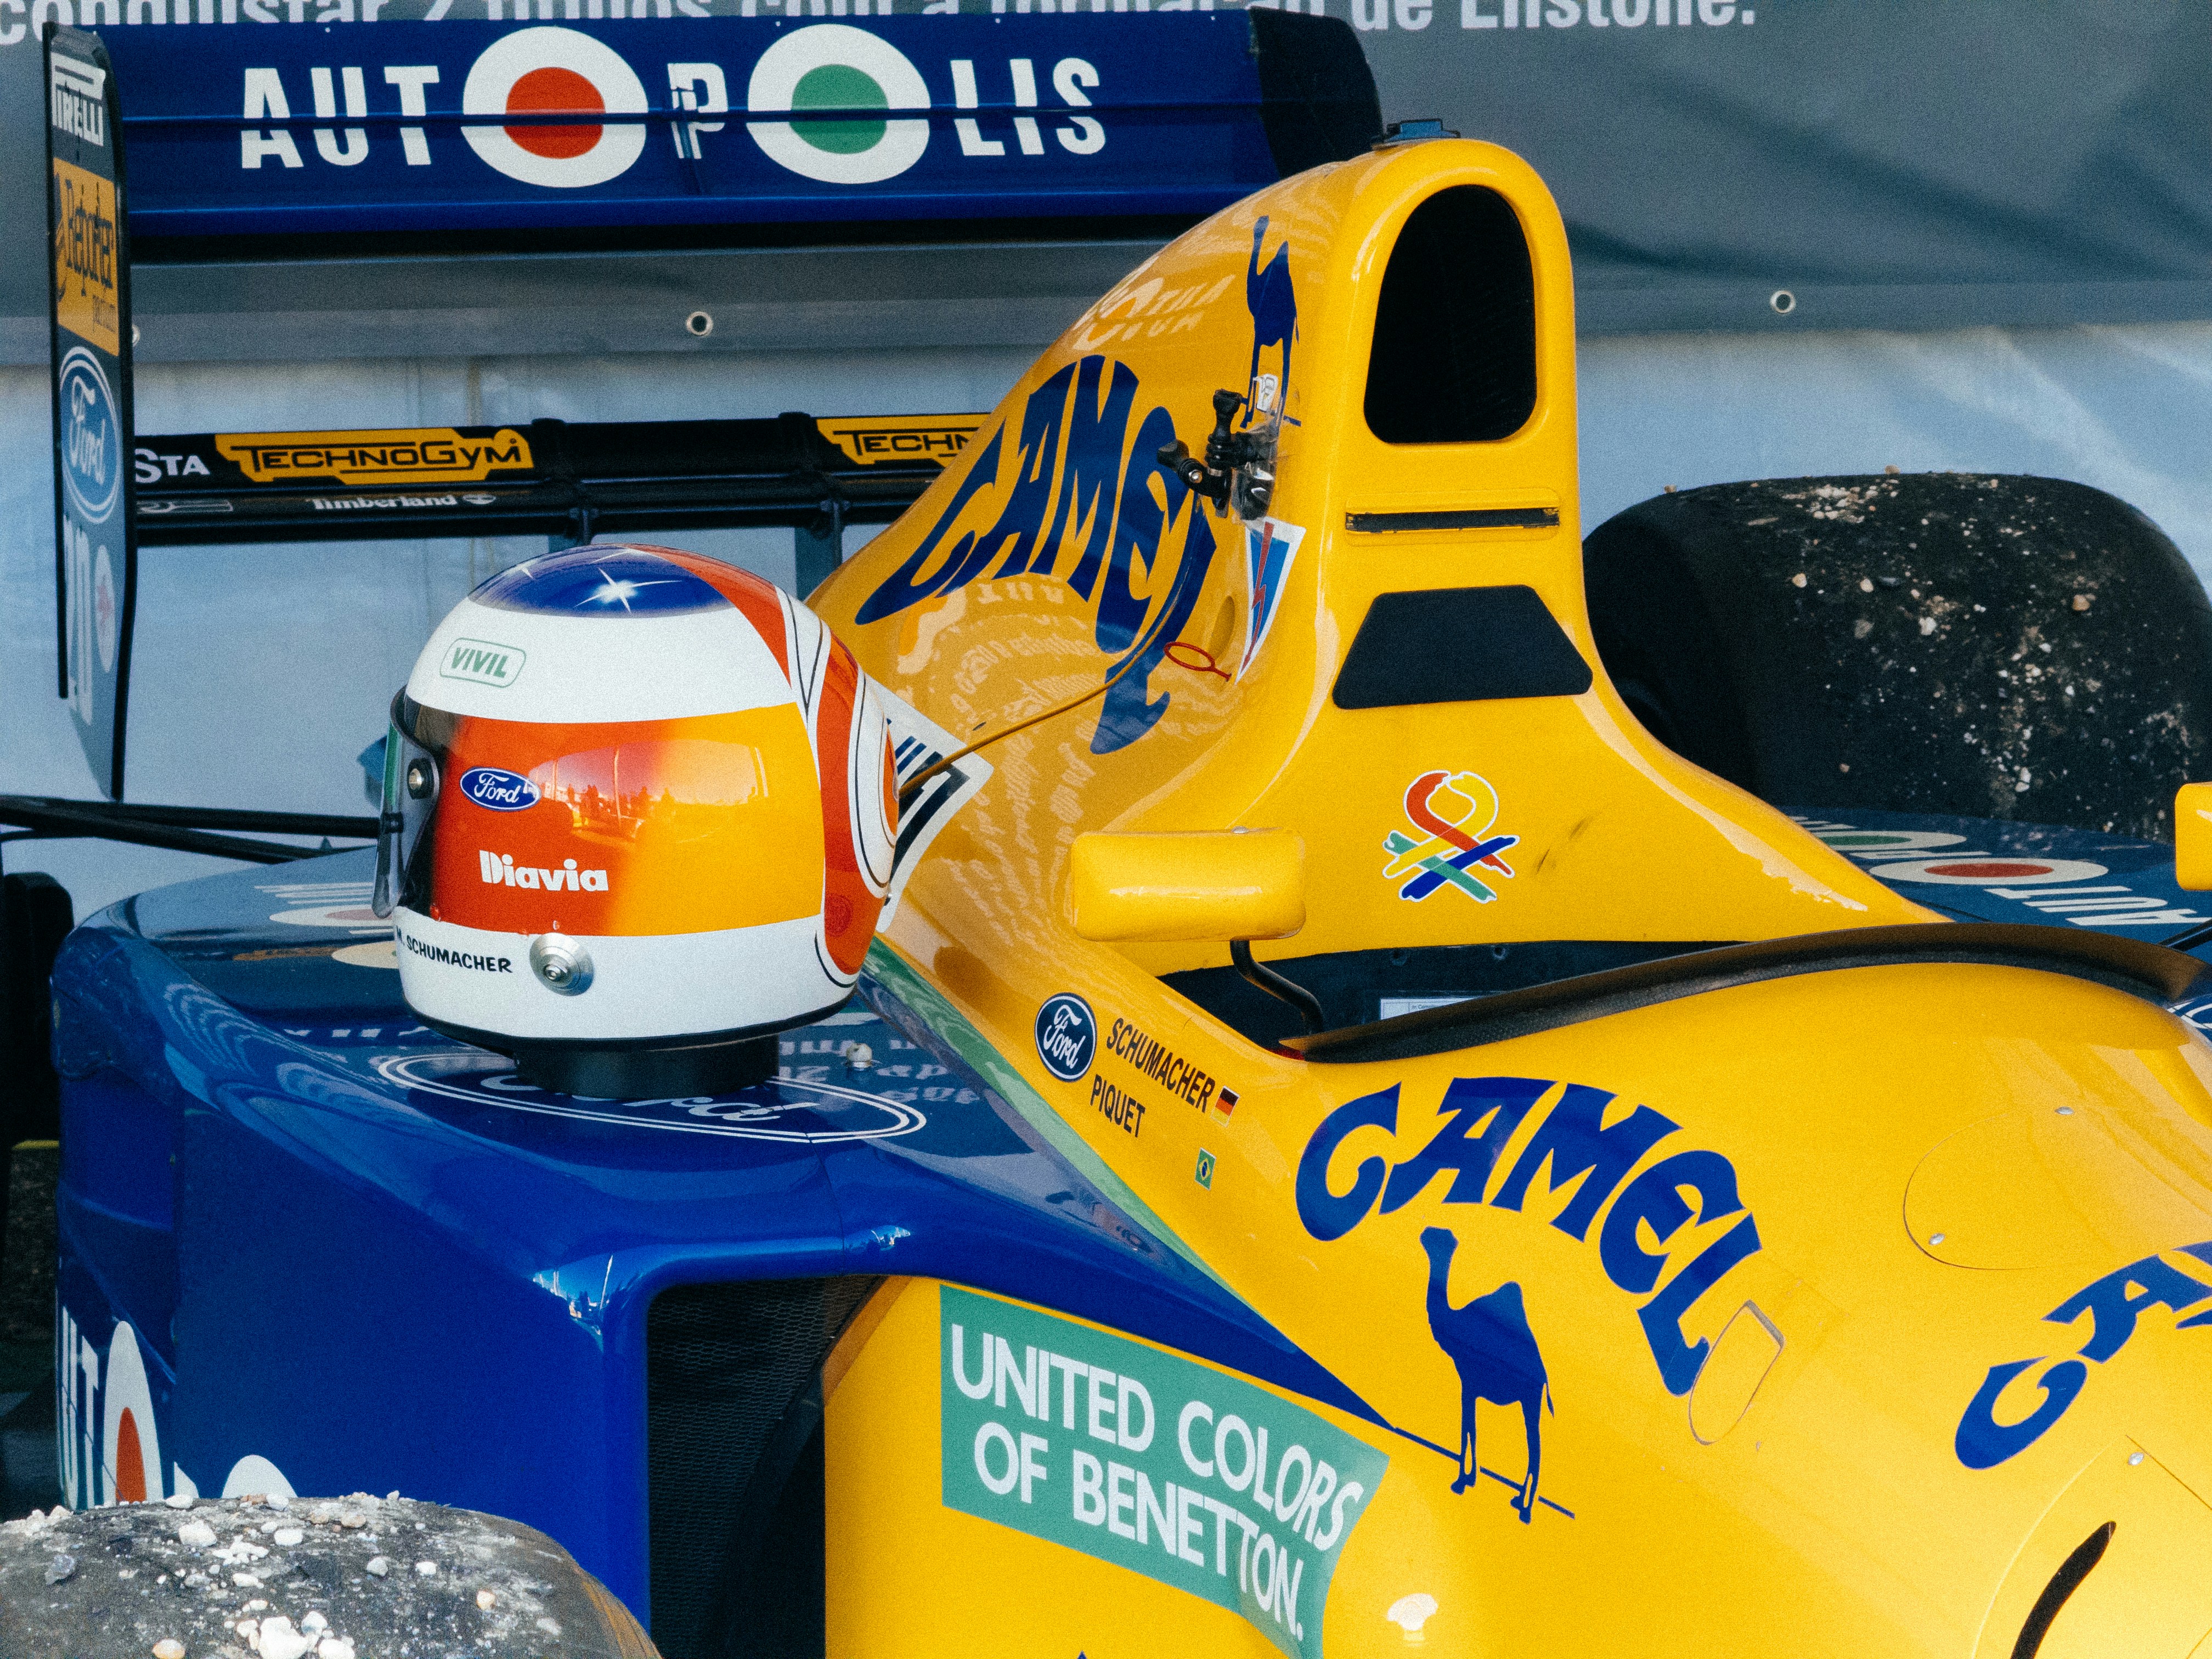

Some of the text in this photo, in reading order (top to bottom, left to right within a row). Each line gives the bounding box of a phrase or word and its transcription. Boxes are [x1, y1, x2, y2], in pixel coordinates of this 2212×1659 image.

[51, 52, 106, 146] PIRELLI
[241, 24, 1106, 188] AUTOPOLIS
[69, 375, 106, 484] Ford
[306, 493, 458, 510] Timberland
[855, 354, 1217, 755] CAMEL
[450, 646, 510, 679] VIVIL
[474, 771, 521, 804] Ford
[479, 849, 609, 892] Diavia
[406, 936, 513, 974] SCHUMACHER
[1042, 1004, 1087, 1070] Ford
[1106, 1018, 1216, 1114] SCHUMACHER
[1090, 1073, 1146, 1138] PIQUET
[1295, 1076, 1763, 1397] CAMEL
[952, 1323, 1364, 1551] UNITED COLORS
[974, 1421, 1304, 1642] OF BENETTON.
